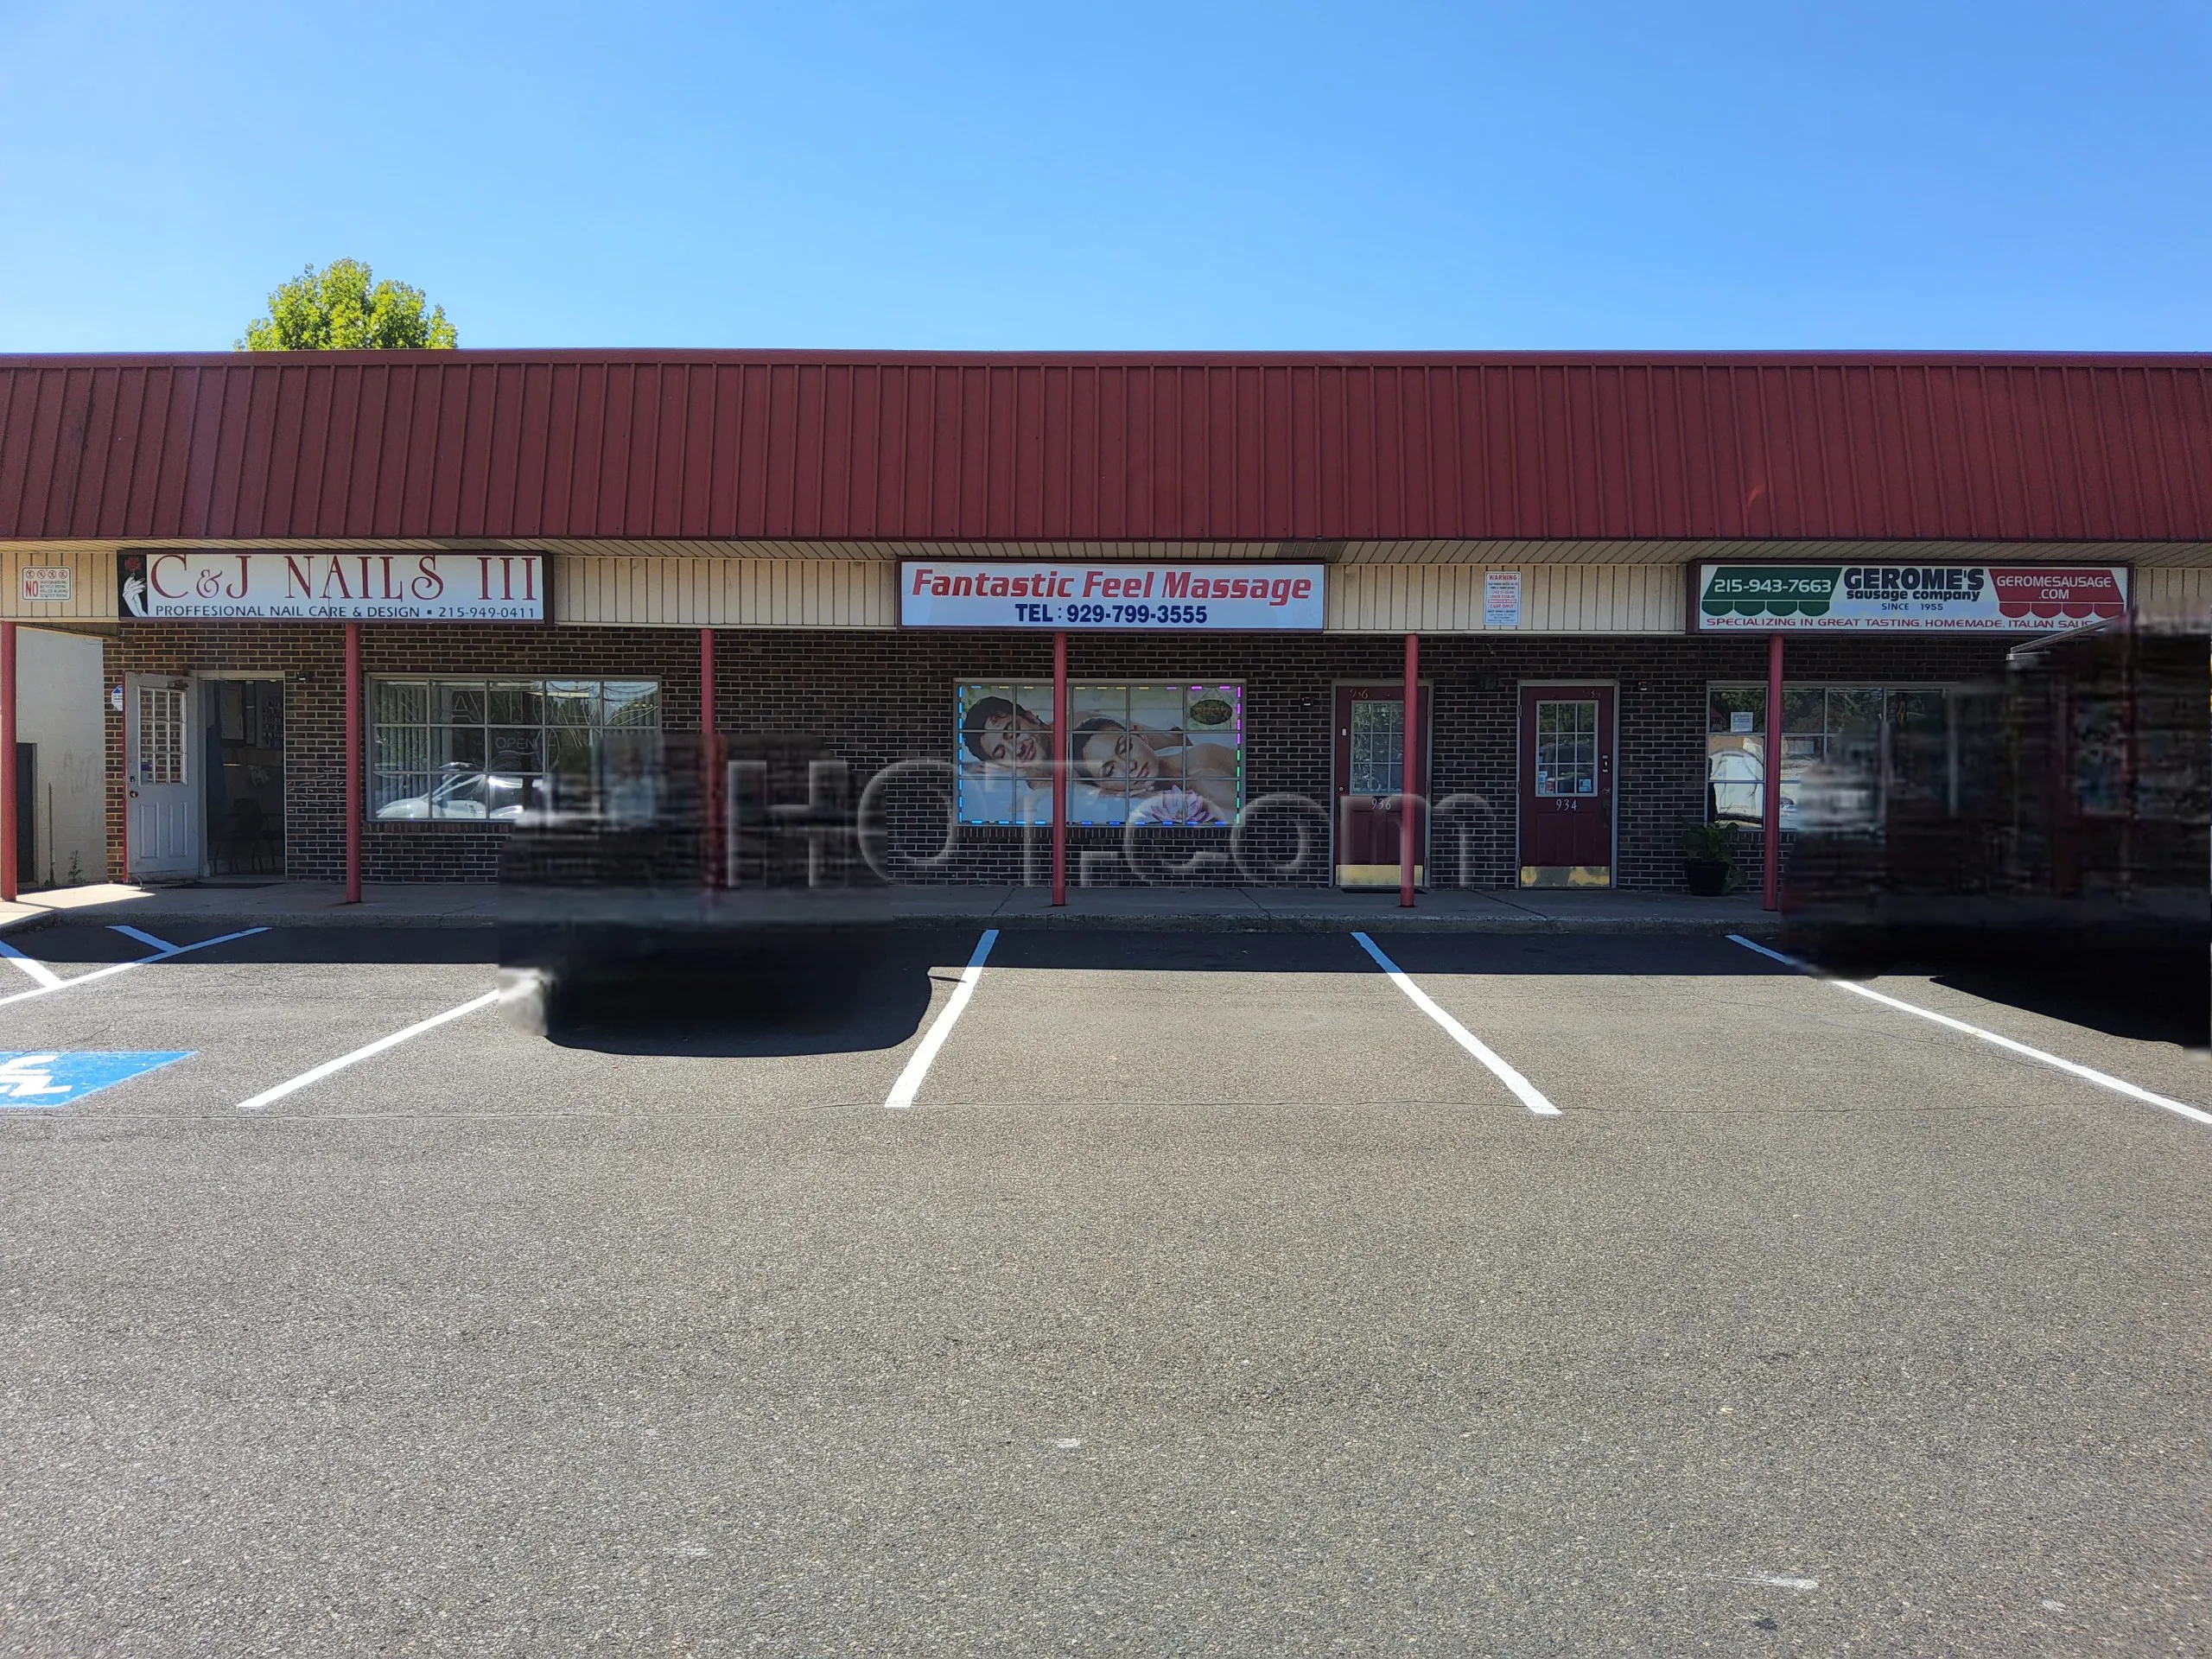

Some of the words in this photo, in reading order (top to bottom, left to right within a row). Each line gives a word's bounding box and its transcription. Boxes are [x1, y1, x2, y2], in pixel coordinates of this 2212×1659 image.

[284, 554, 444, 602] NAILS
[477, 556, 537, 601] III
[1844, 567, 1985, 591] GEROME'S
[1997, 575, 2112, 588] GEROMESAUSAGE
[26, 581, 38, 597] NO
[912, 569, 1075, 598] Fantastic
[1083, 570, 1155, 598] Feel
[1161, 571, 1312, 607] Massage
[1714, 579, 1832, 593] 215-943-7663
[1847, 590, 1908, 601] sausage
[1912, 590, 1980, 601] company
[2038, 589, 2069, 600] .COM
[156, 605, 264, 616] PROFFESIONAL
[270, 606, 303, 617] NAIL
[308, 606, 346, 617] CARE
[353, 607, 362, 617] &
[367, 607, 420, 618] DESIGN
[439, 607, 534, 618] 215-949-0411
[1067, 605, 1207, 623] 929-799-3555
[1707, 618, 1796, 626] SPECIALIZING
[2008, 620, 2054, 628] ITALIAN
[496, 737, 537, 749] OPEN
[1371, 798, 1391, 810] 936
[1556, 798, 1577, 811] 934
